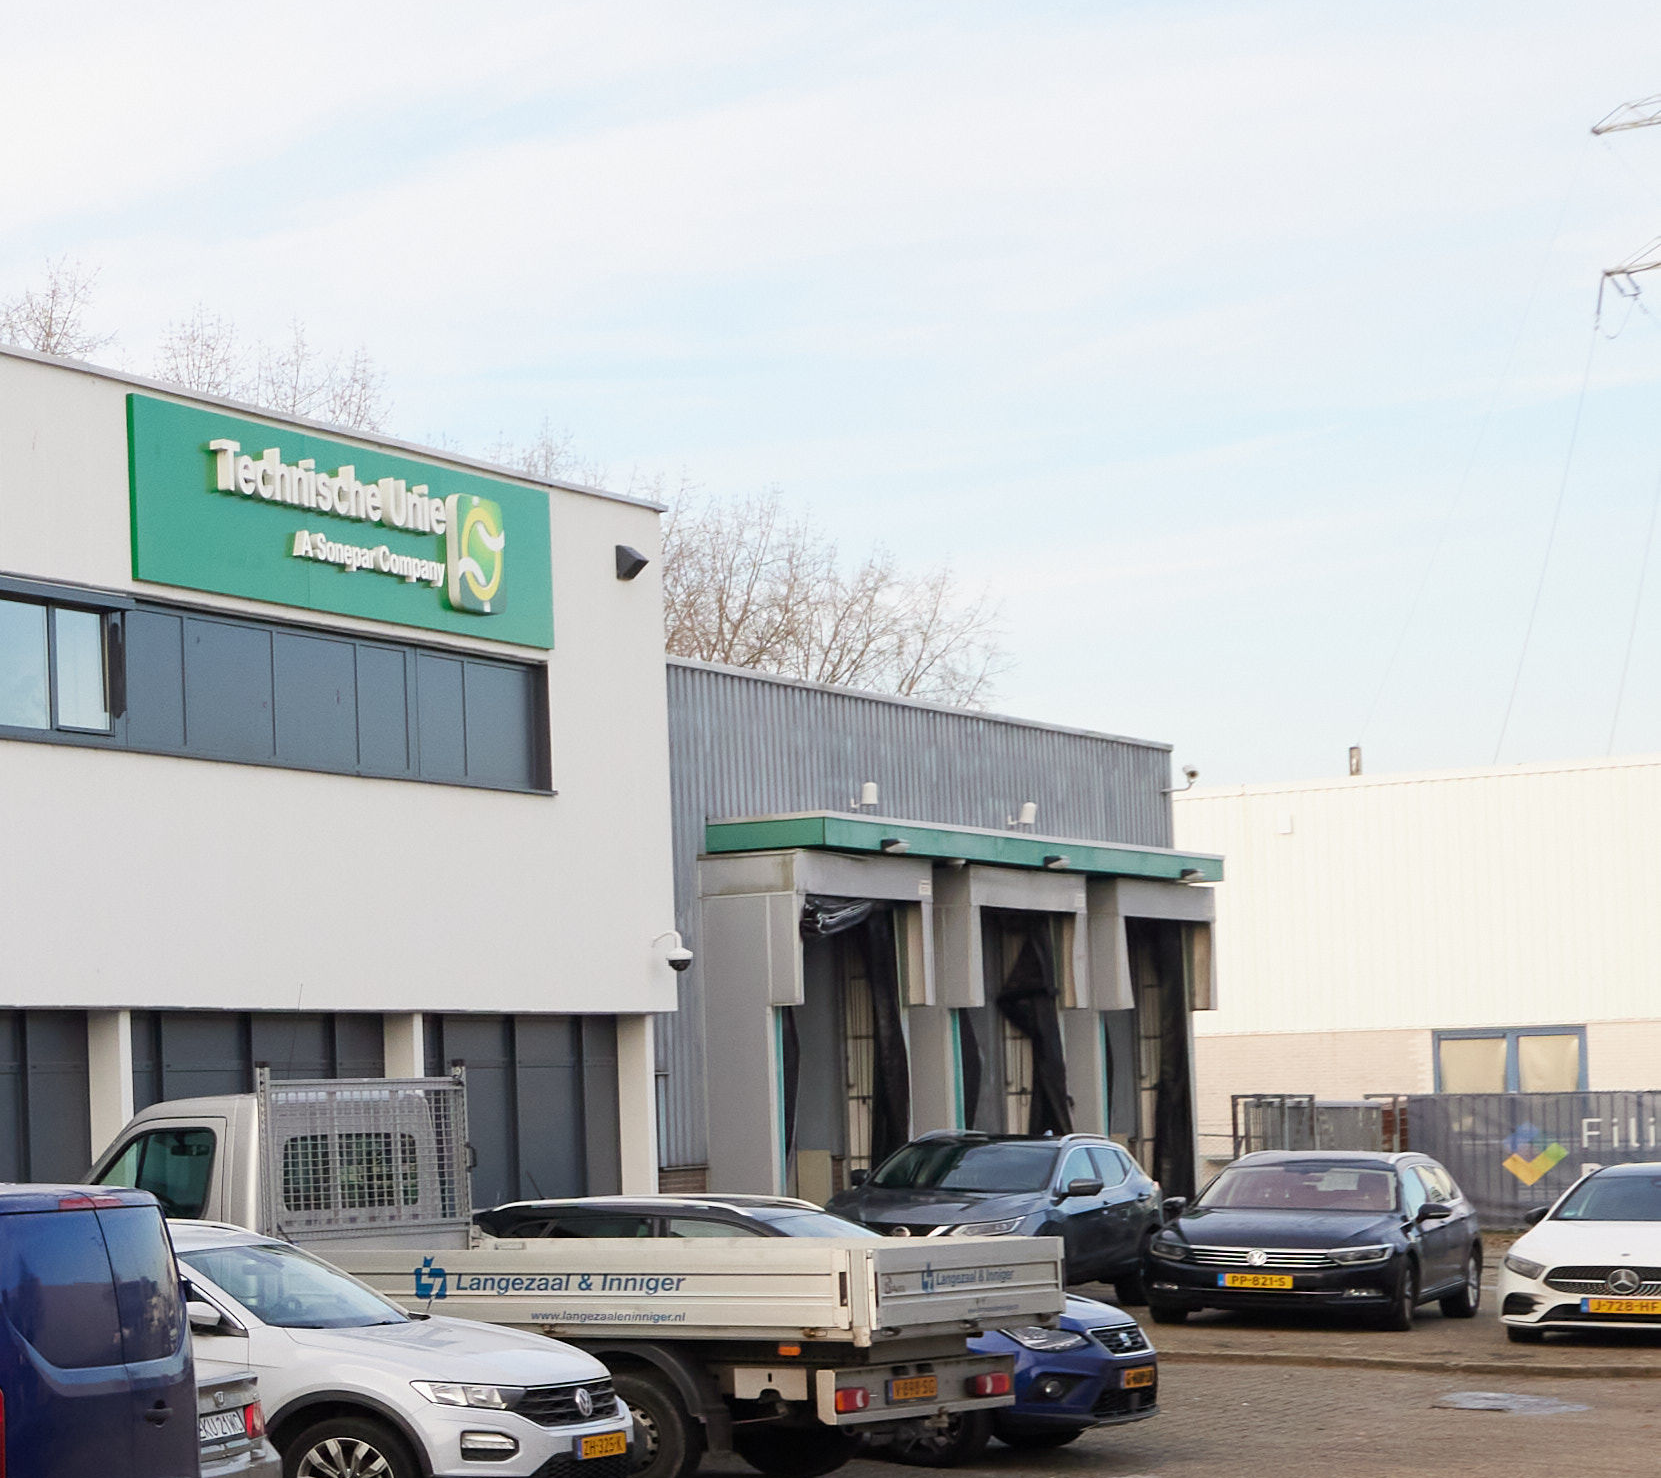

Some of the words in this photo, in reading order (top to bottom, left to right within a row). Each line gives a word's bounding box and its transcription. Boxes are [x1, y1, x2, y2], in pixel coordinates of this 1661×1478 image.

[209, 438, 382, 522] Technische
[378, 476, 447, 535] Unie
[293, 530, 315, 557] A
[314, 533, 378, 572] Sonepar
[375, 545, 445, 588] Company
[456, 1274, 569, 1296] Langezaal
[577, 1274, 593, 1291] &
[601, 1274, 686, 1296] Inniger
[1231, 1275, 1286, 1287] PP-821-S
[530, 1310, 686, 1324] www.langezaaleninniger.nl
